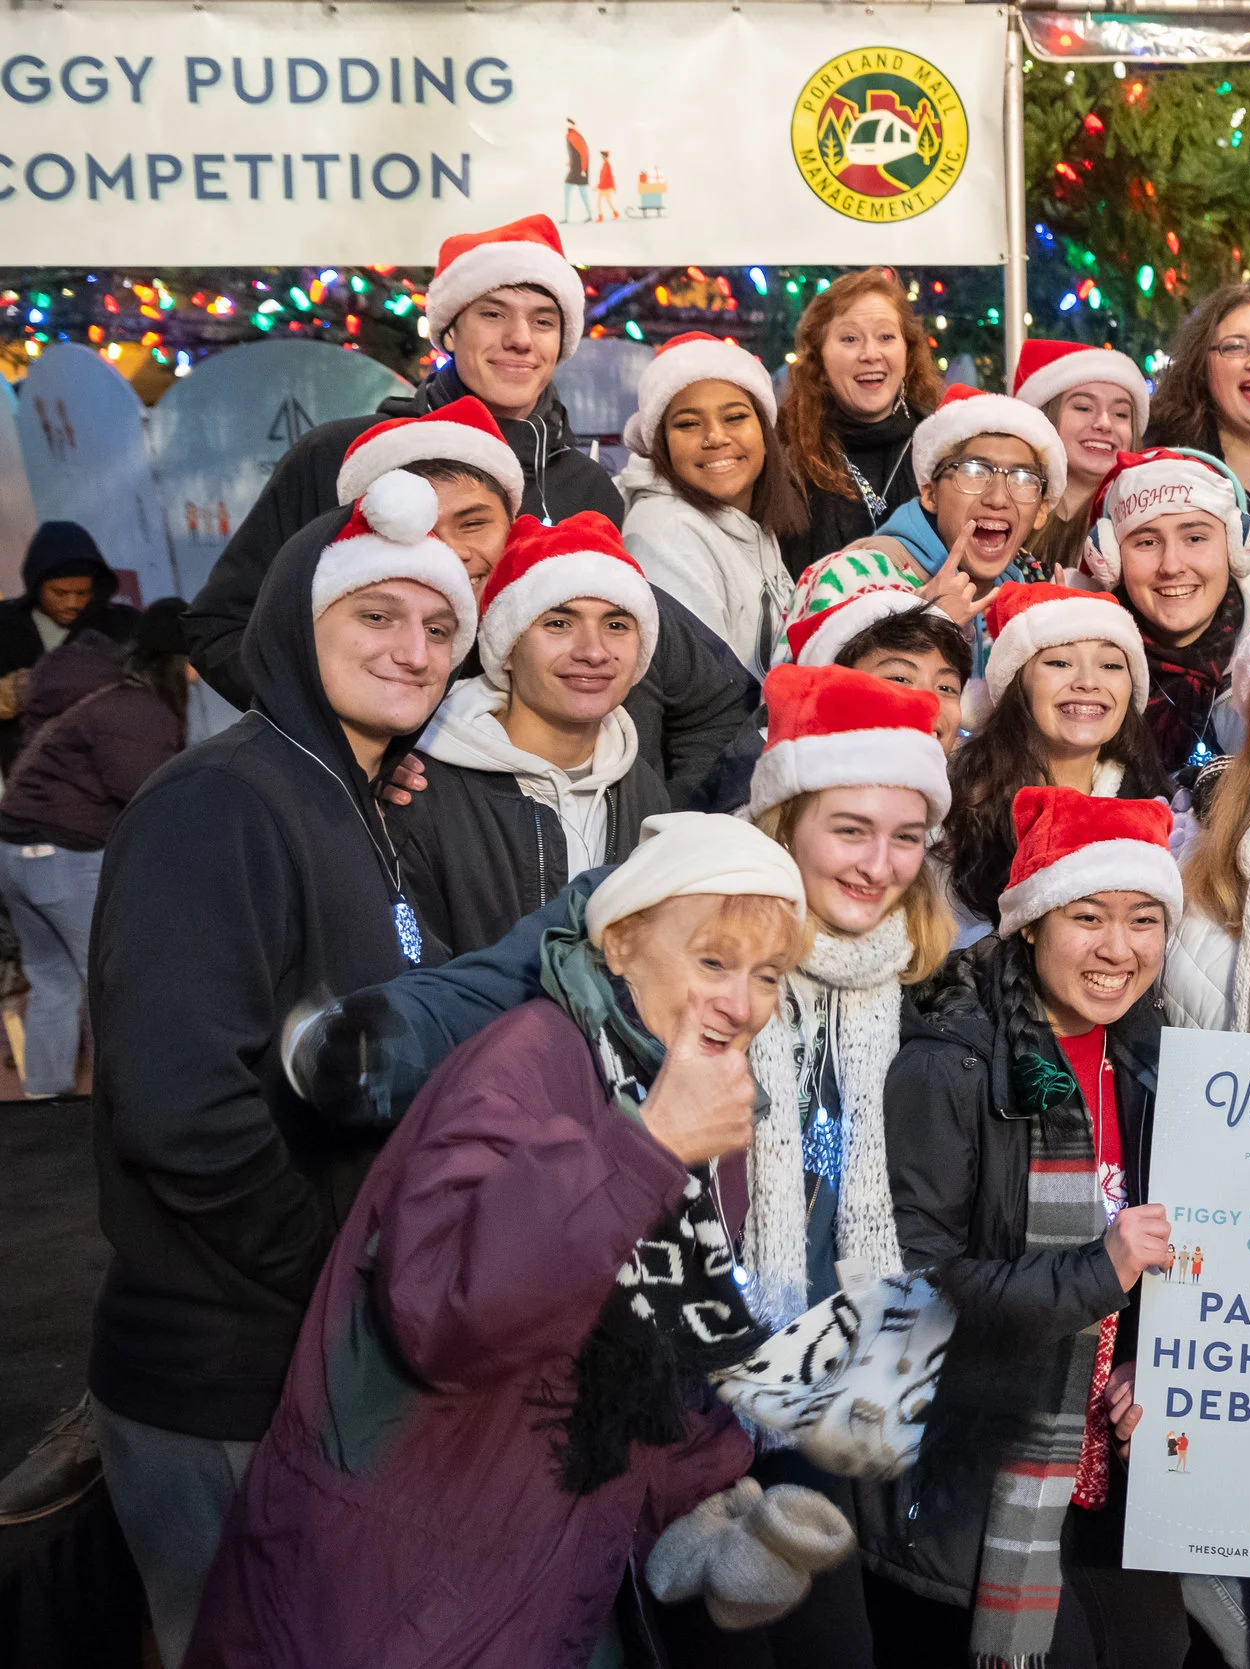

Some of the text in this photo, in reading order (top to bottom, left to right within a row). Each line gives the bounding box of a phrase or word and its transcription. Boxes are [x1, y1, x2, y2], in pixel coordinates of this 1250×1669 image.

[186, 56, 514, 104] PUDDING
[803, 53, 957, 116] PORTLAND MALL
[1174, 1206, 1242, 1227] FIGGY
